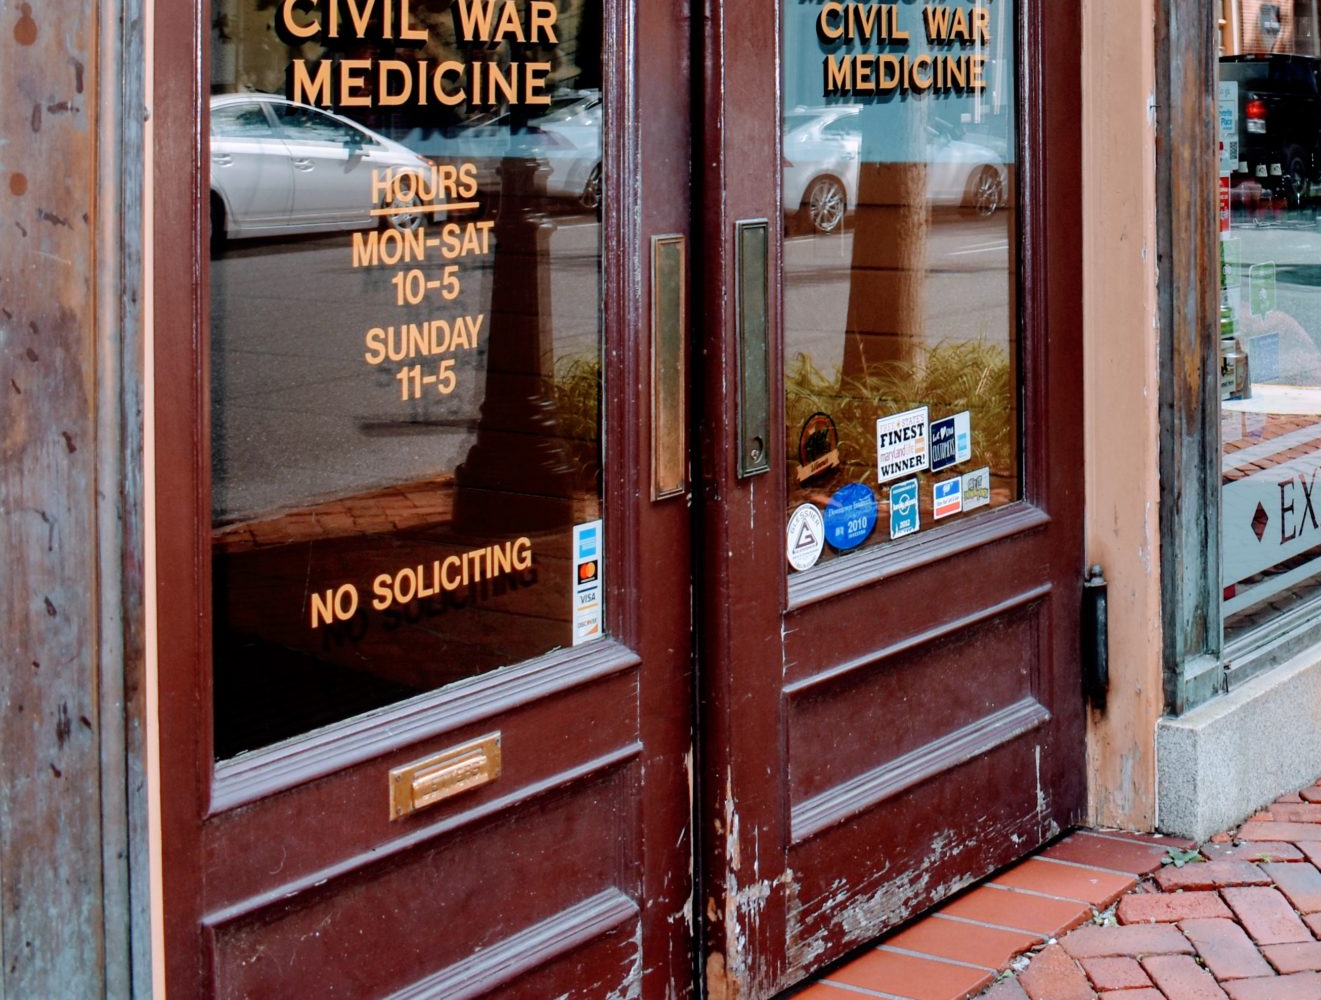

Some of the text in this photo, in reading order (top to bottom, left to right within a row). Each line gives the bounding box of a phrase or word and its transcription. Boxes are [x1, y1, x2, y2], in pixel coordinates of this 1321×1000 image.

[820, 2, 990, 41] CIVIL WAR
[293, 59, 552, 108] MEDICINE
[827, 55, 987, 91] MEDICINE
[371, 163, 478, 204] HOURS
[351, 221, 495, 268] MON-SAT
[390, 265, 460, 306] 10-5
[364, 314, 484, 365] SUNDAY
[395, 360, 456, 400] 11-5
[880, 423, 925, 448] FINEST
[881, 454, 926, 477] WINNER!
[847, 516, 868, 534] 2010
[310, 537, 532, 628] NO SOLICITING
[580, 592, 596, 604] VISA
